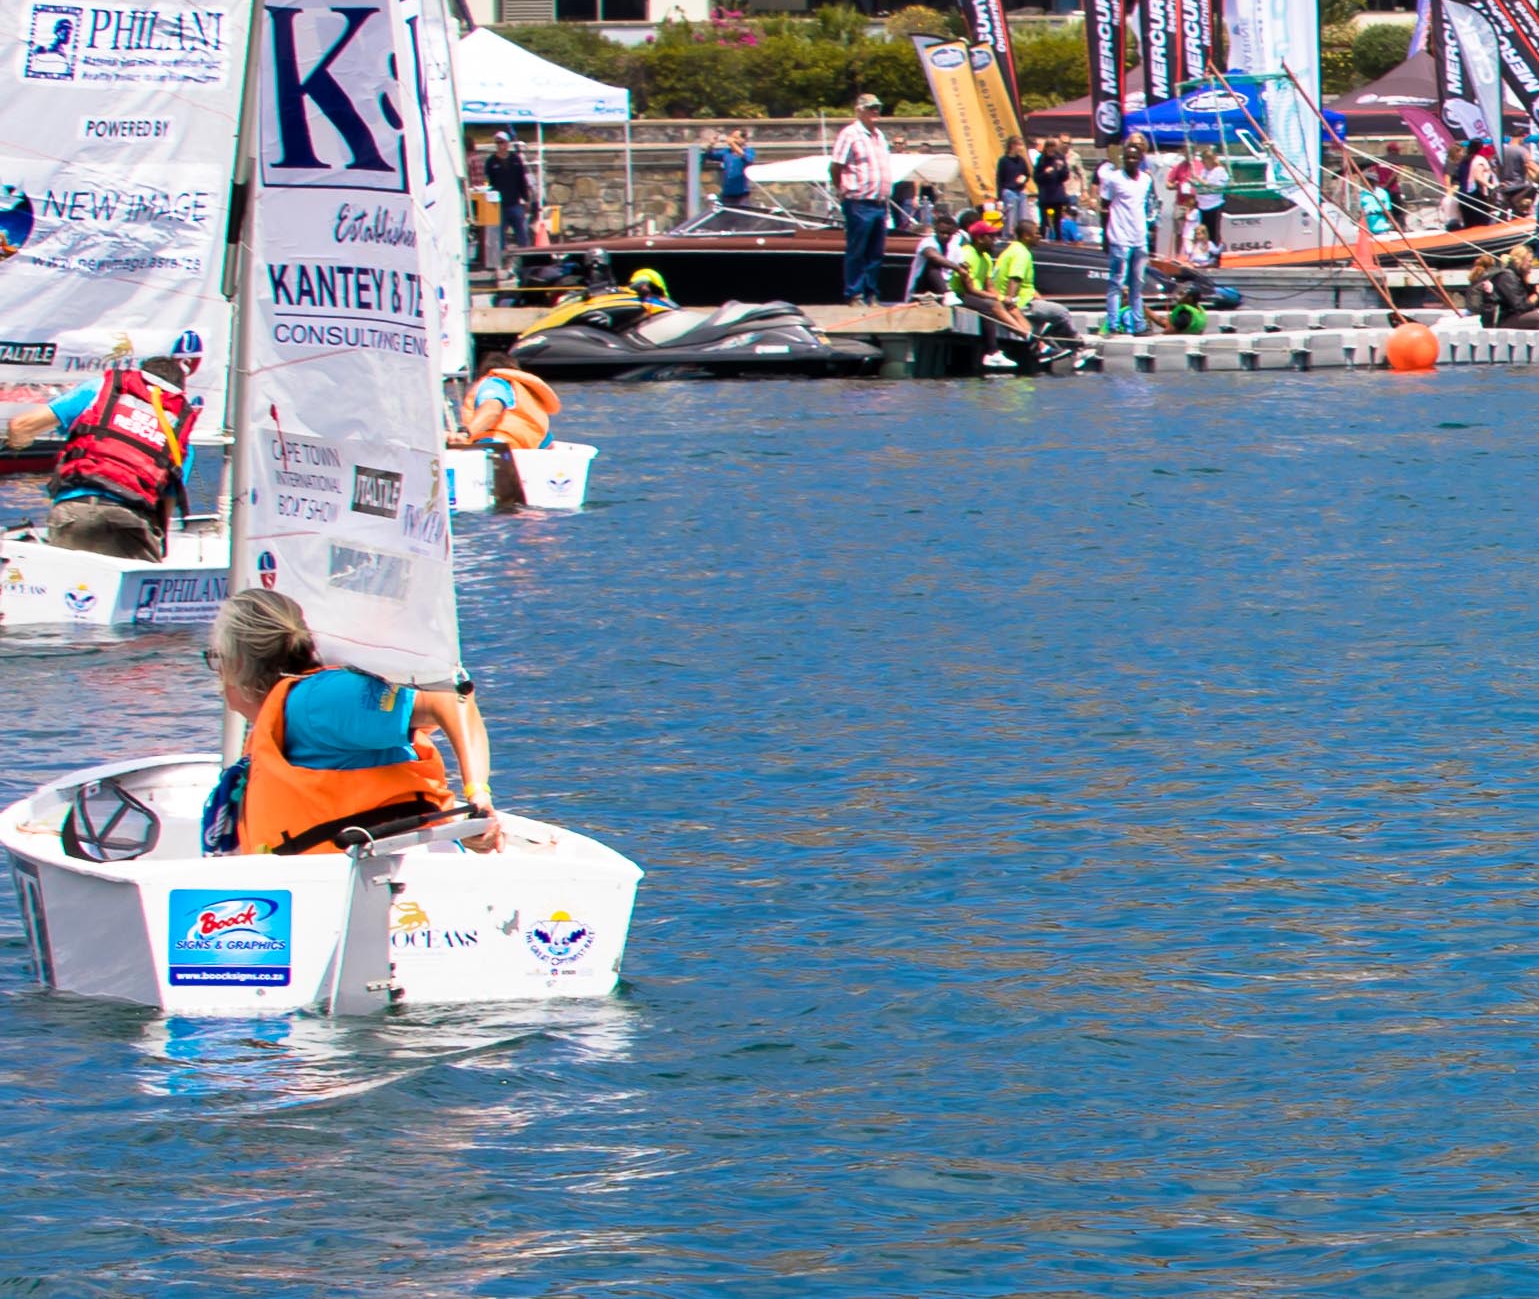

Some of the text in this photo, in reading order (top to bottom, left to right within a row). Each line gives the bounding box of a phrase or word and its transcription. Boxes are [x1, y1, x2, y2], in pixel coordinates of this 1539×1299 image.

[86, 121, 169, 137] POWERED BY
[43, 191, 119, 221] NEW
[268, 264, 384, 309] KANTEY
[391, 270, 402, 312] &
[275, 323, 400, 351] CONSULTING
[114, 414, 167, 447] RESCUE
[131, 410, 158, 430] SEA
[306, 443, 341, 467] TOWN
[200, 905, 256, 934] Boock
[176, 941, 286, 950] SIGNS & GRAPHICS
[392, 930, 478, 948] OCEANS
[176, 972, 284, 981] www.boocksigns.co.za
